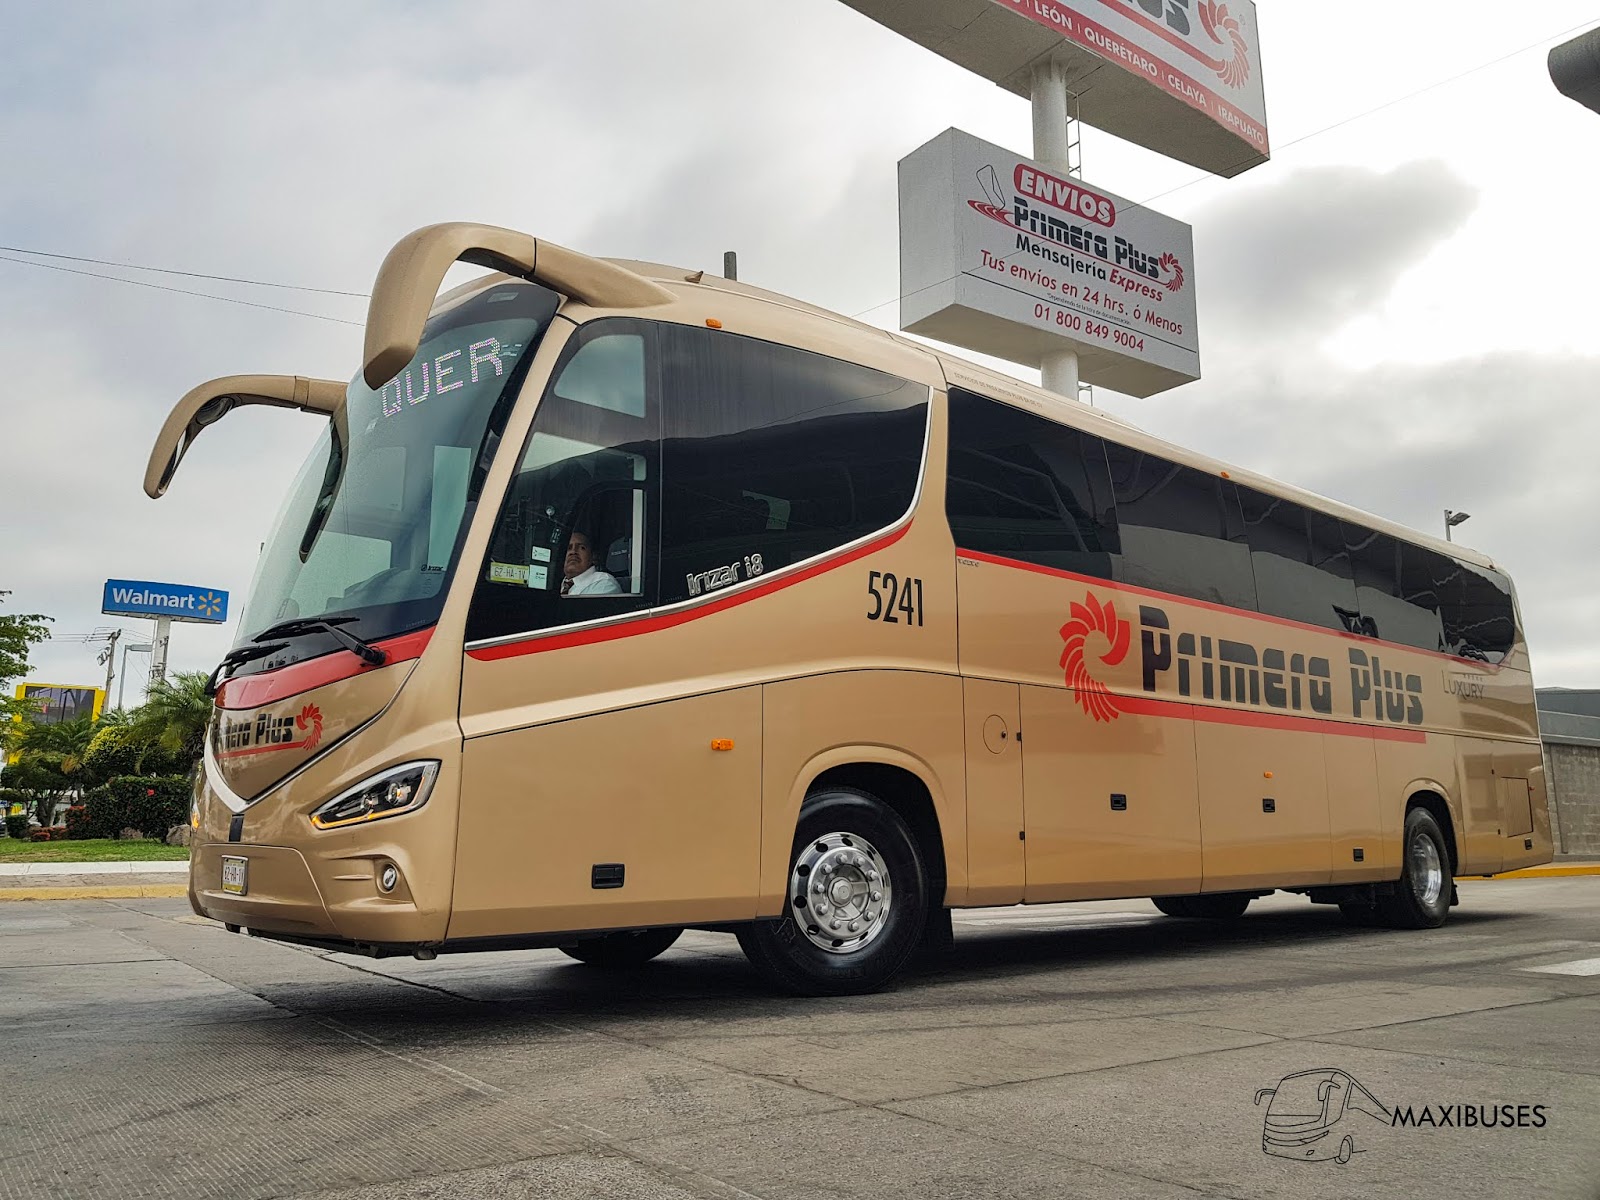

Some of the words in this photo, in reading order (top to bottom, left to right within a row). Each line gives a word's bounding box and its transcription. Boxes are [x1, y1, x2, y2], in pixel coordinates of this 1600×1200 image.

[1034, 0, 1073, 31] LEÓN
[1084, 27, 1158, 77] QUERÉTARO
[1167, 74, 1207, 108] CELAYA
[1218, 105, 1265, 145] IRAPUATO
[1020, 168, 1111, 226] ENVIOS
[1014, 196, 1108, 259] Primera
[1115, 235, 1159, 279] Plus
[1016, 233, 1107, 281] Mensajería
[1109, 269, 1163, 302] Express
[981, 249, 1005, 272] Tus
[1010, 264, 1057, 291] envíos
[1062, 282, 1078, 298] en
[1083, 286, 1100, 305] 24
[1104, 293, 1128, 316] hrs.
[1133, 304, 1141, 320] ó
[1145, 312, 1183, 335] Menos
[1034, 303, 1050, 321] 01
[1056, 310, 1081, 331] 800
[1085, 321, 1109, 339] 849
[1113, 329, 1144, 352] 9004
[382, 337, 503, 418] QUER
[112, 588, 196, 610] Walmart
[686, 562, 741, 597] Irizar
[744, 553, 764, 578] i8
[867, 571, 923, 627] 5241
[1139, 605, 1332, 714] Primera
[1348, 647, 1424, 725] Plus
[255, 713, 294, 745] Plus
